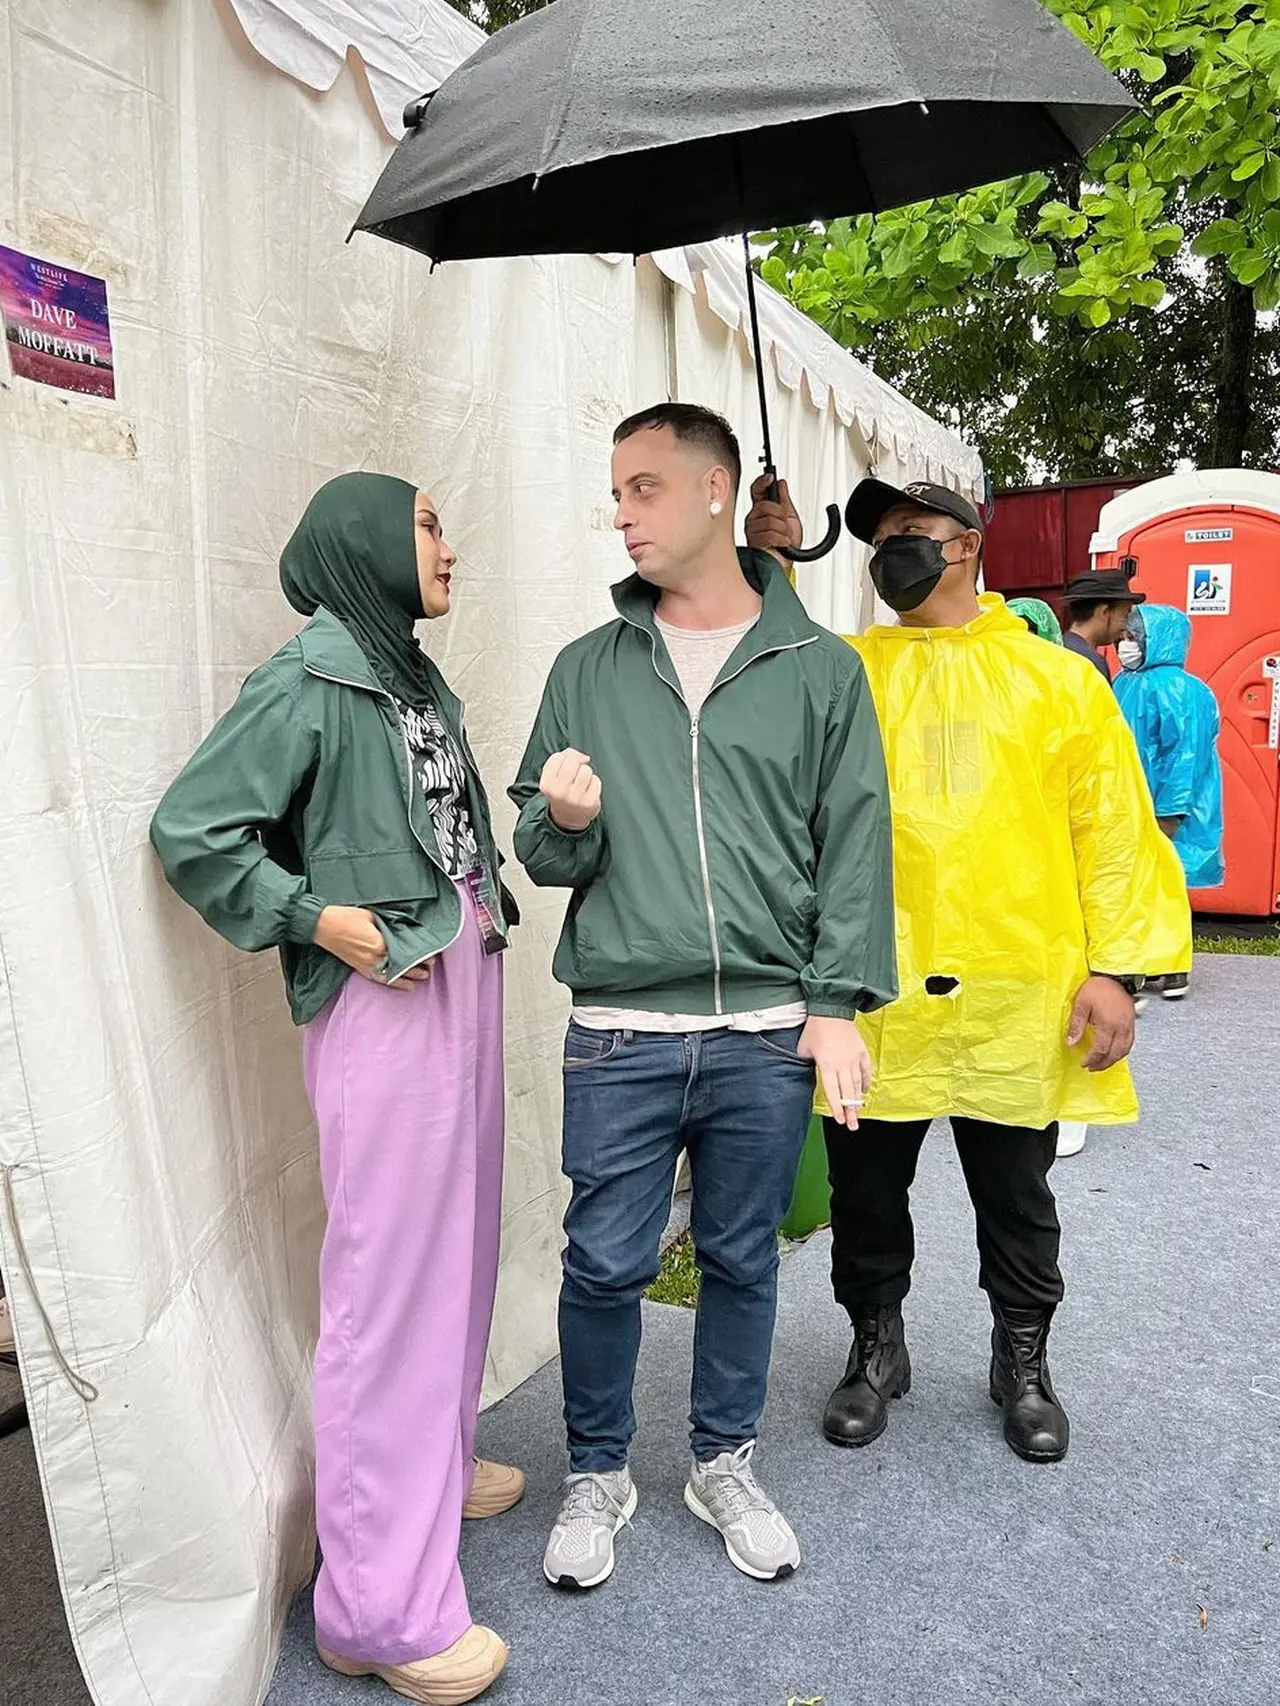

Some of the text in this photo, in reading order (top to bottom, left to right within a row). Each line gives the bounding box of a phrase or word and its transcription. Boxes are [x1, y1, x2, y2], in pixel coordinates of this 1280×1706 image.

[31, 298, 77, 329] DAVE
[18, 325, 99, 365] MOFFATT
[1197, 531, 1230, 540] TOILET
